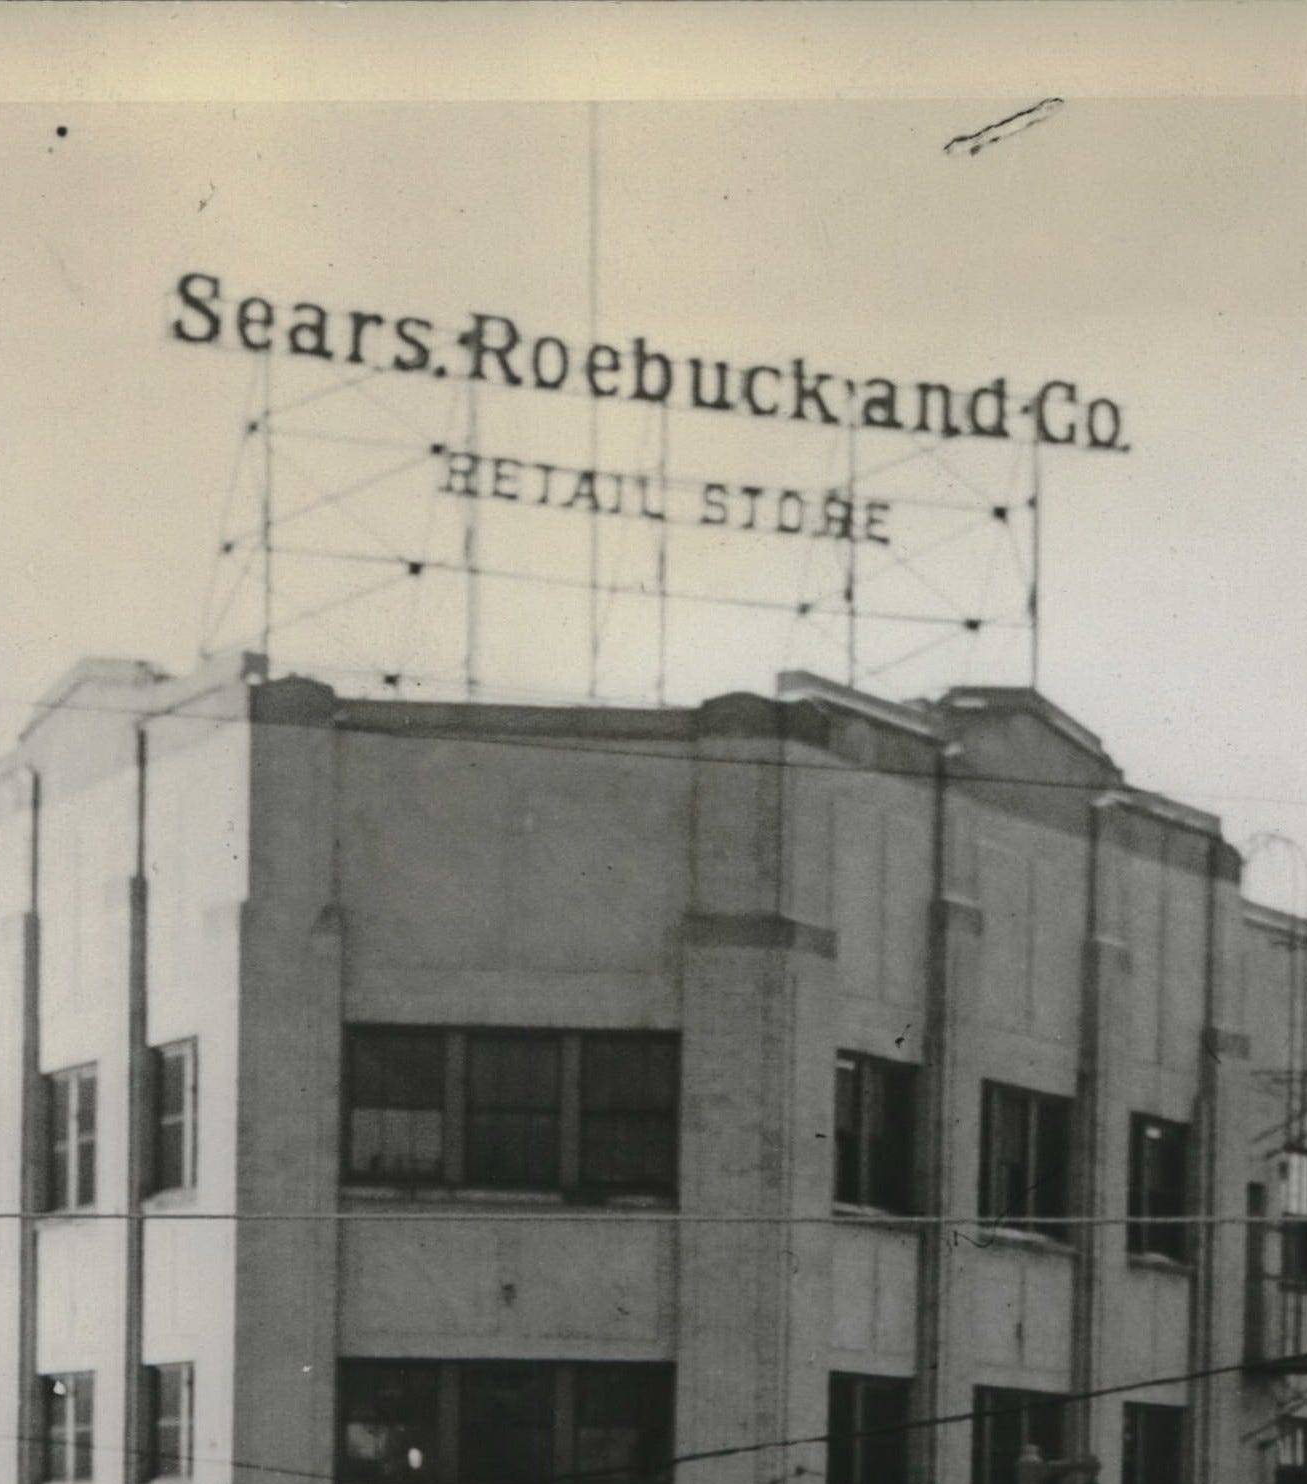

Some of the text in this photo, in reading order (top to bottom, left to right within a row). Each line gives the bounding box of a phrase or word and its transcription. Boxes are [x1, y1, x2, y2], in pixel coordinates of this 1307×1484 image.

[472, 312, 839, 426] Roebuck
[862, 377, 1008, 438] and
[440, 452, 890, 545] RETAIL STORE
